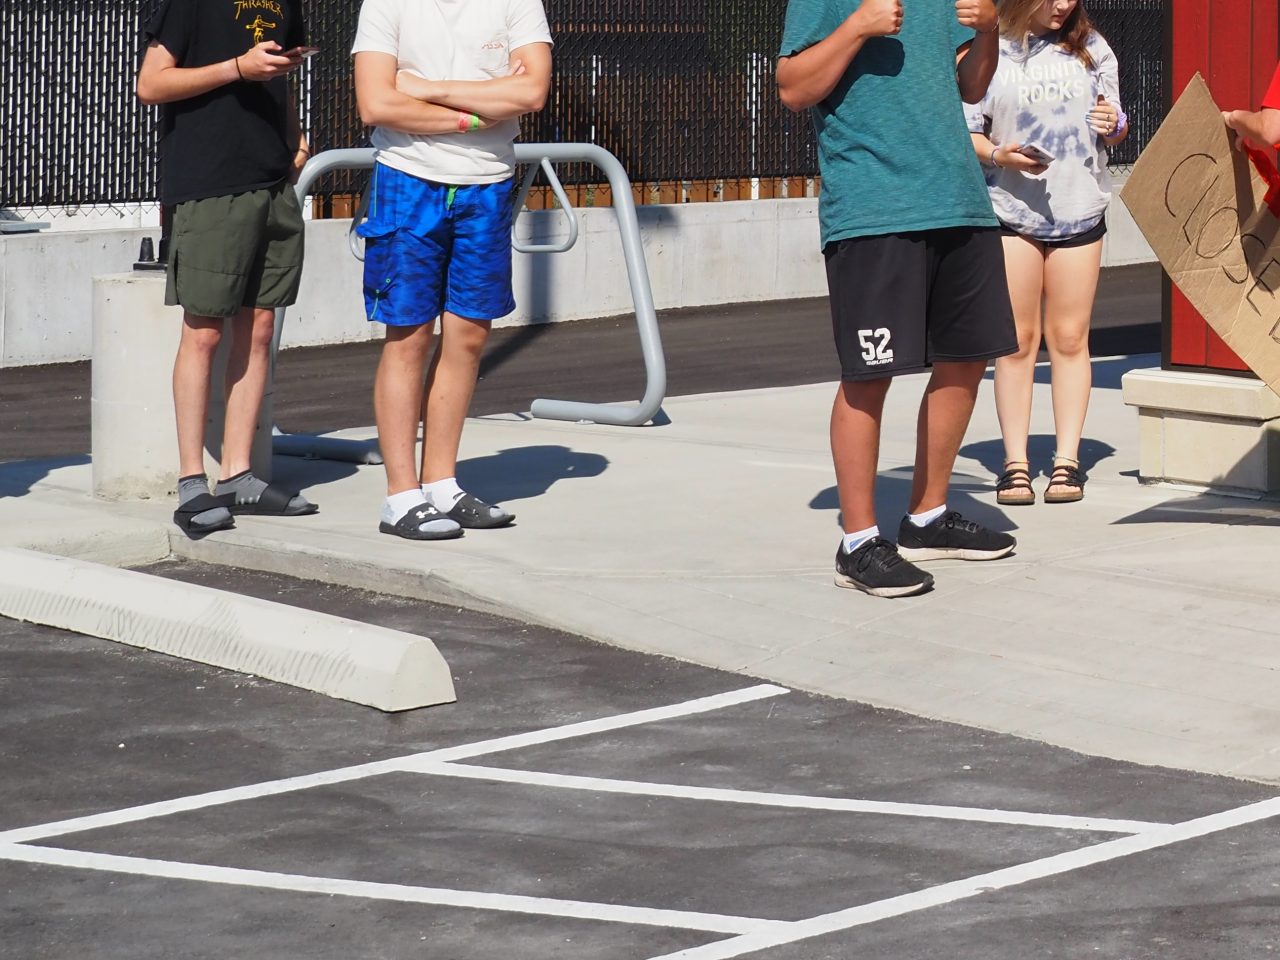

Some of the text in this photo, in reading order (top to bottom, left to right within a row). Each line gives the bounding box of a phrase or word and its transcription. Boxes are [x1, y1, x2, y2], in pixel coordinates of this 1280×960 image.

[233, 0, 284, 19] THRASHER
[999, 61, 1087, 87] VIRGINIT
[1018, 78, 1085, 105] ROCKS
[857, 327, 894, 361] 52
